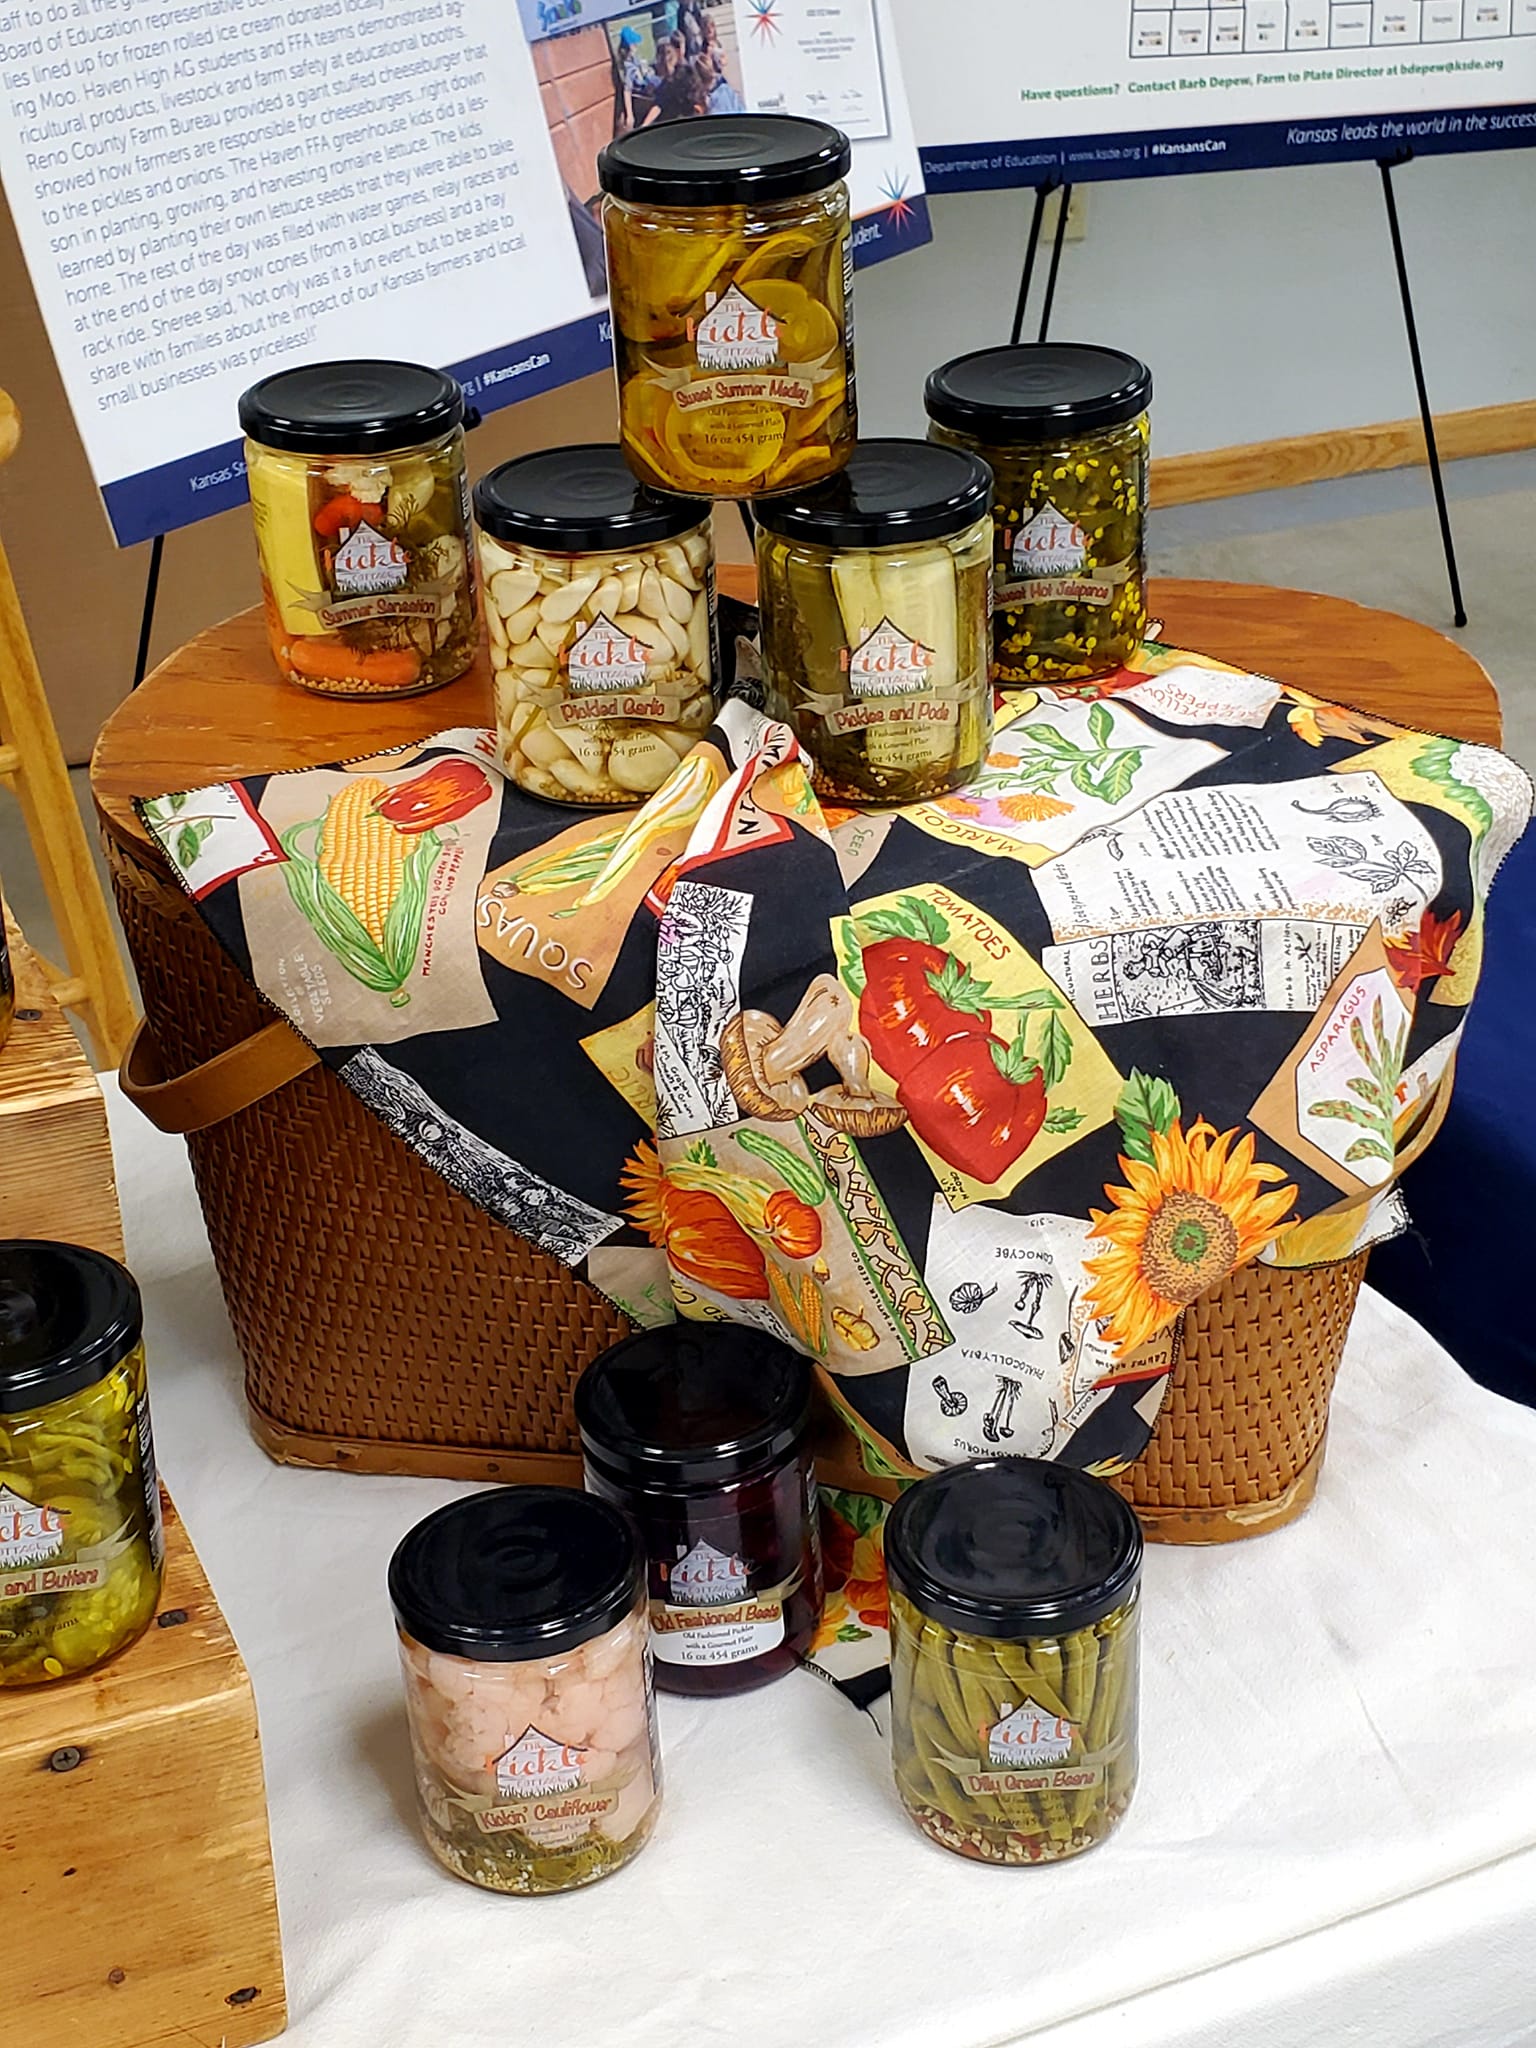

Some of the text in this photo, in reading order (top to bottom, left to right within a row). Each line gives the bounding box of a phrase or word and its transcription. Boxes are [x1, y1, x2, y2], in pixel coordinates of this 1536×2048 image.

[11, 100, 37, 117] ing
[82, 77, 132, 99] Haven
[133, 67, 170, 88] High
[173, 59, 196, 78] AG
[195, 48, 258, 72] students
[258, 38, 286, 58] and
[286, 32, 313, 51] FFA
[313, 25, 355, 45] teams
[357, 1, 444, 34] demonstrated
[19, 113, 87, 143] ricultural
[159, 81, 224, 108] livestock
[225, 73, 253, 92] and
[254, 69, 287, 85] farm
[288, 58, 327, 79] safety
[330, 51, 343, 66] at
[344, 33, 419, 62] educational
[1021, 89, 1051, 102] Have
[1054, 84, 1120, 101] questions?
[1128, 79, 1178, 94] Contact
[1179, 76, 1206, 91] Barb
[1256, 73, 1285, 85] Farm
[1287, 72, 1301, 83] to
[1303, 69, 1334, 82] Plate
[1336, 65, 1385, 80] Director
[1386, 66, 1398, 76] at
[26, 150, 68, 171] Reno
[70, 134, 126, 163] County
[129, 125, 168, 145] Farm
[169, 112, 221, 135] Bureau
[223, 93, 283, 125] provided
[285, 94, 295, 106] a
[296, 82, 331, 105] giant
[331, 70, 377, 94] stuffed
[379, 51, 461, 83] cheeseburger
[1287, 127, 1338, 145] Kansas
[1341, 123, 1378, 141] leads
[1381, 120, 1404, 138] the
[1406, 117, 1445, 135] world
[1448, 116, 1462, 133] in
[1465, 113, 1488, 131] the
[924, 158, 988, 175] Department
[991, 157, 1003, 169] of
[1004, 152, 1057, 168] Education
[1152, 140, 1226, 156] #KansansCan
[50, 234, 80, 252] son
[81, 229, 97, 243] in
[230, 181, 257, 204] and
[258, 166, 328, 195] harvesting
[329, 150, 382, 174] romaine
[431, 130, 457, 147] The
[456, 120, 483, 138] kids
[90, 361, 132, 384] share
[132, 349, 166, 370] with
[167, 332, 223, 359] families
[225, 317, 266, 341] about
[267, 311, 291, 328] the
[340, 287, 354, 304] of
[357, 282, 378, 299] our
[381, 268, 425, 291] Kansas
[425, 253, 472, 277] farmers
[473, 242, 496, 262] and
[496, 233, 527, 255] local
[98, 353, 248, 410] small businesses was
[675, 379, 809, 408] Sweet Summer Medley
[705, 433, 717, 445] 16
[734, 433, 754, 445] 454
[189, 467, 232, 492] Kansas
[1030, 582, 1052, 597] Hot
[321, 598, 435, 626] Summer Sensation
[560, 697, 665, 722] Pickled Garlic
[833, 701, 949, 730] Pickles and Pods
[627, 743, 656, 757] grams
[916, 807, 1022, 853] MARIGOL
[926, 888, 1012, 961] TOMATOES
[1089, 940, 1119, 1020] HERBS
[1309, 985, 1366, 1073] ASPARAGUS
[608, 1066, 654, 1112] RLIC
[995, 1247, 1054, 1265] CONOCYBE
[4, 1569, 99, 1596] and Butters
[675, 1607, 742, 1629] Fashioned
[745, 1604, 780, 1620] Beets
[697, 1629, 731, 1639] Fashioned
[732, 1625, 754, 1635] Pickles
[681, 1645, 759, 1661] 16 oz 454 grams
[967, 1770, 1096, 1794] Dilly Green Beans
[534, 1798, 613, 1821] Cauliflower
